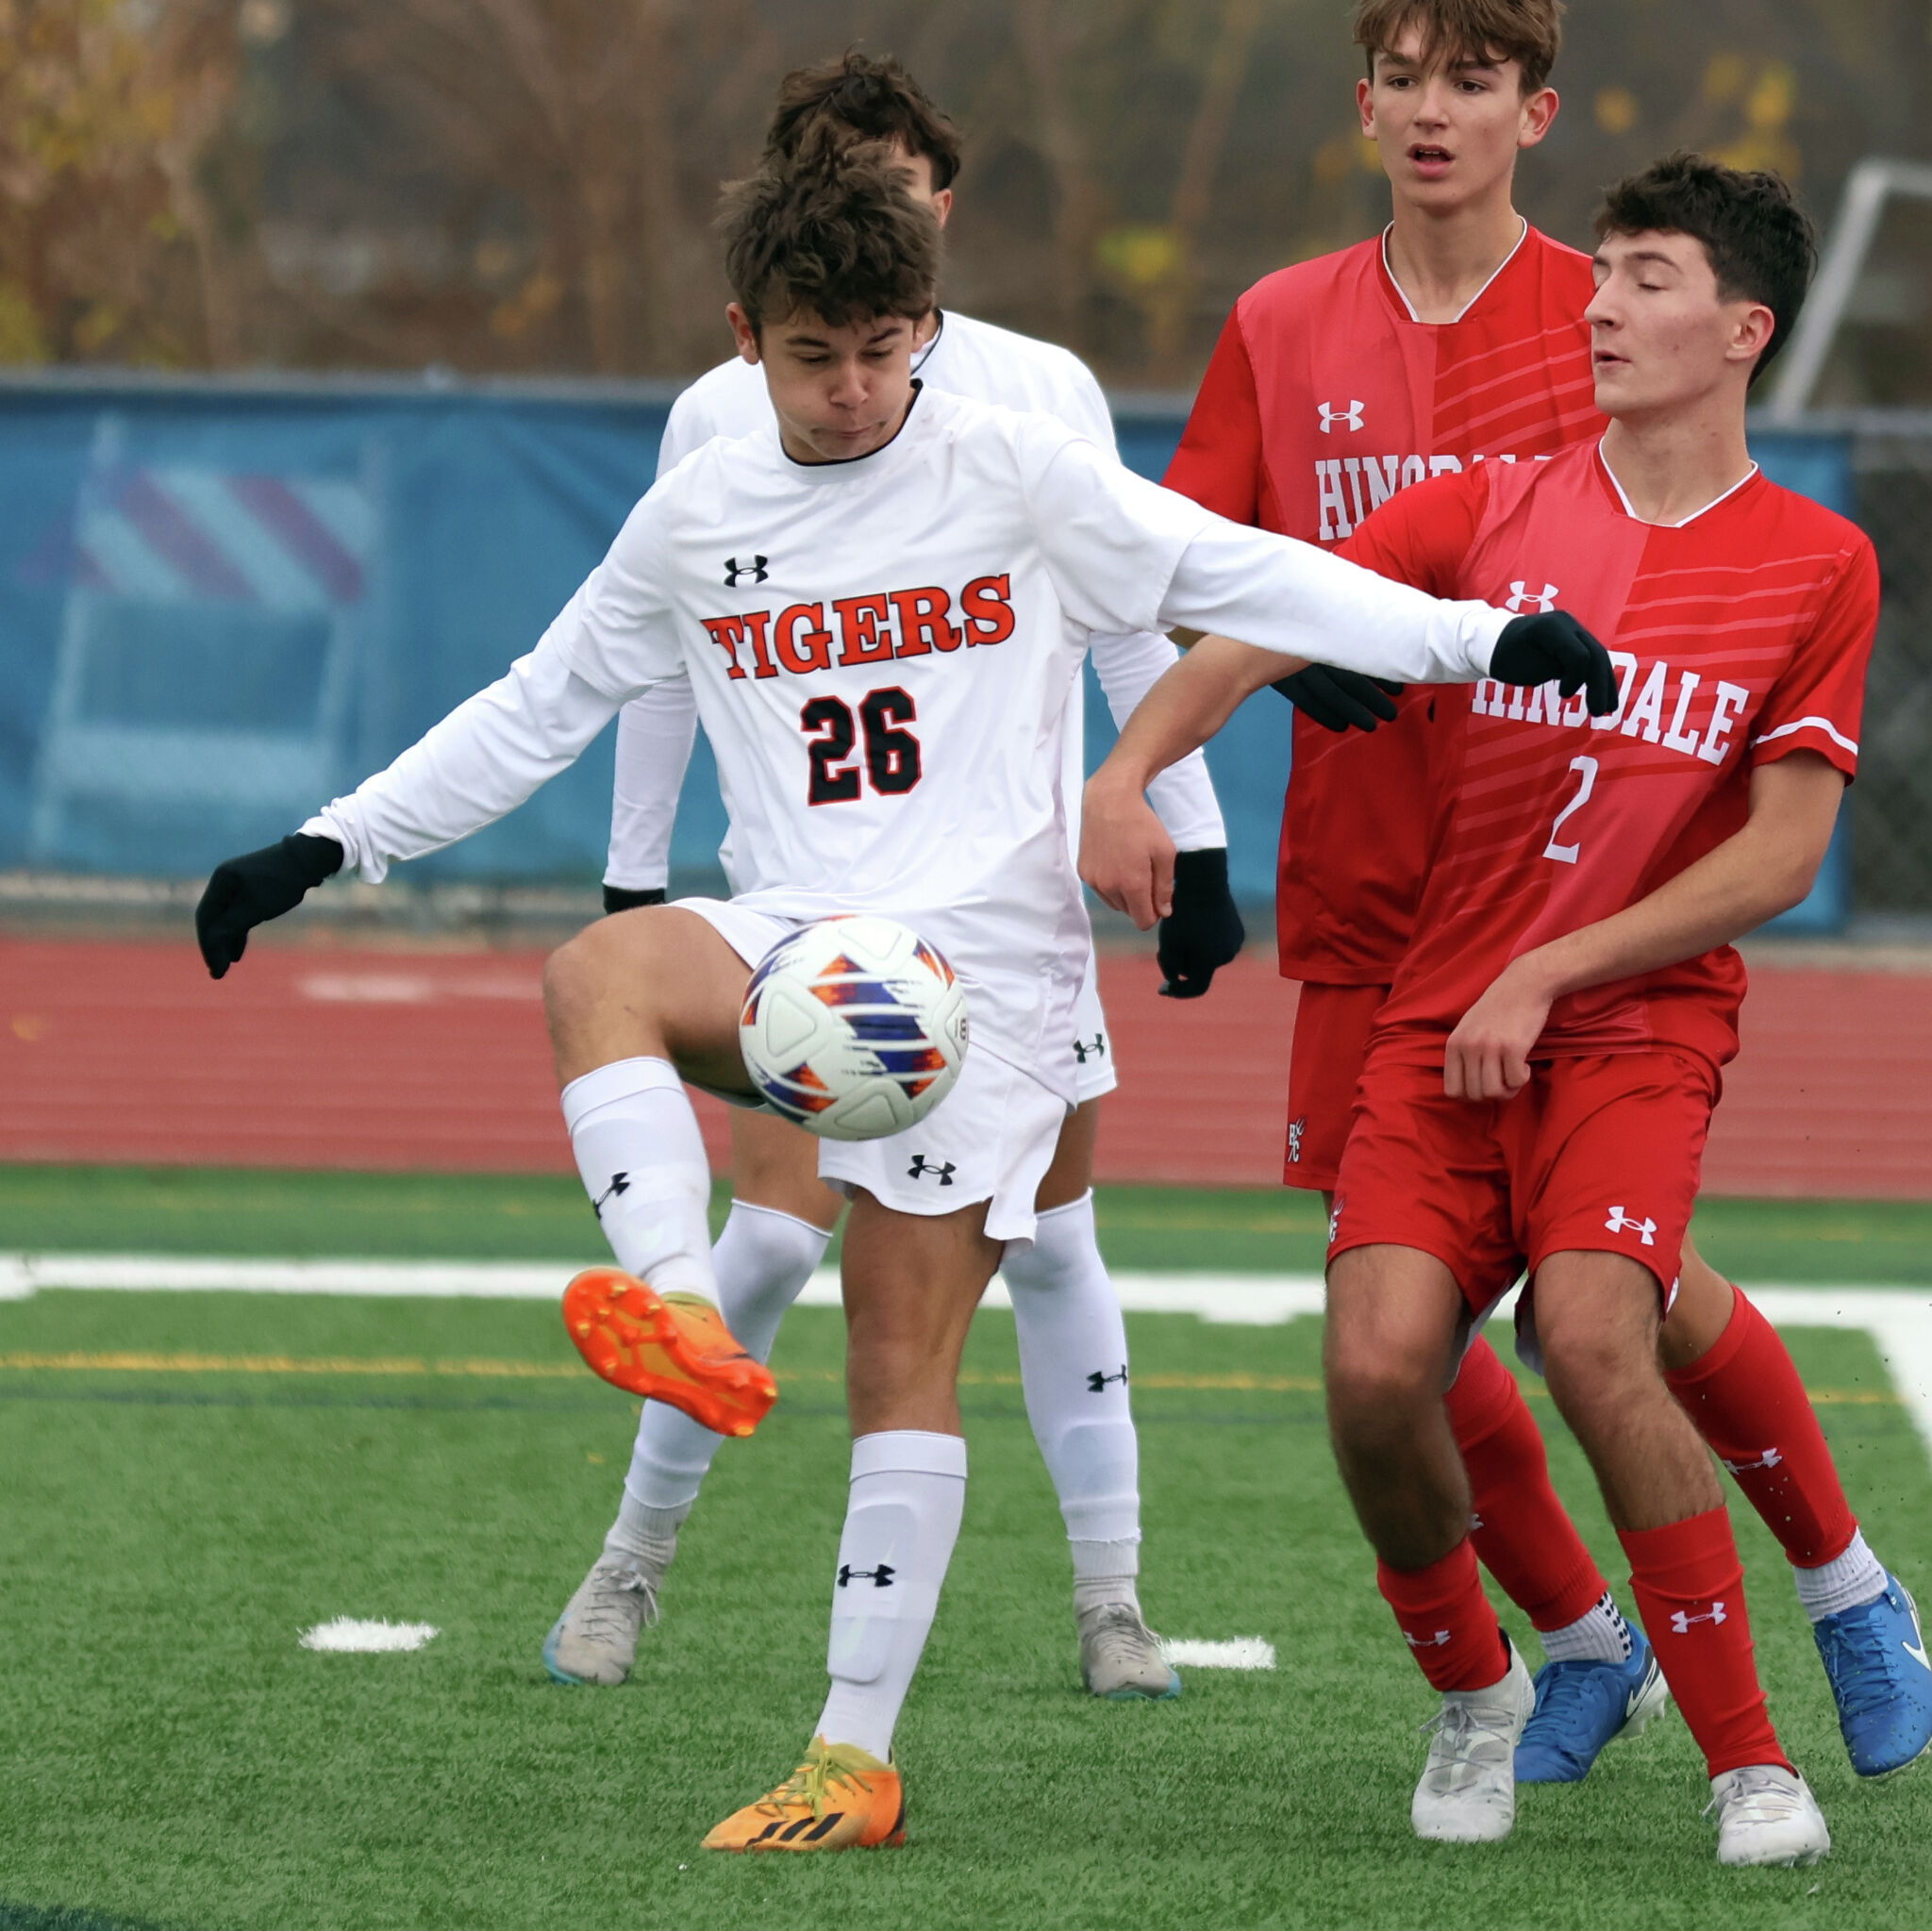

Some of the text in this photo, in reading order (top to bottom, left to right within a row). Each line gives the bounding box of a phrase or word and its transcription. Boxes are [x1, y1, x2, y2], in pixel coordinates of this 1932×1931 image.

[699, 574, 1015, 680] TIGERS
[800, 686, 922, 807] 26
[1542, 756, 1599, 864] 2
